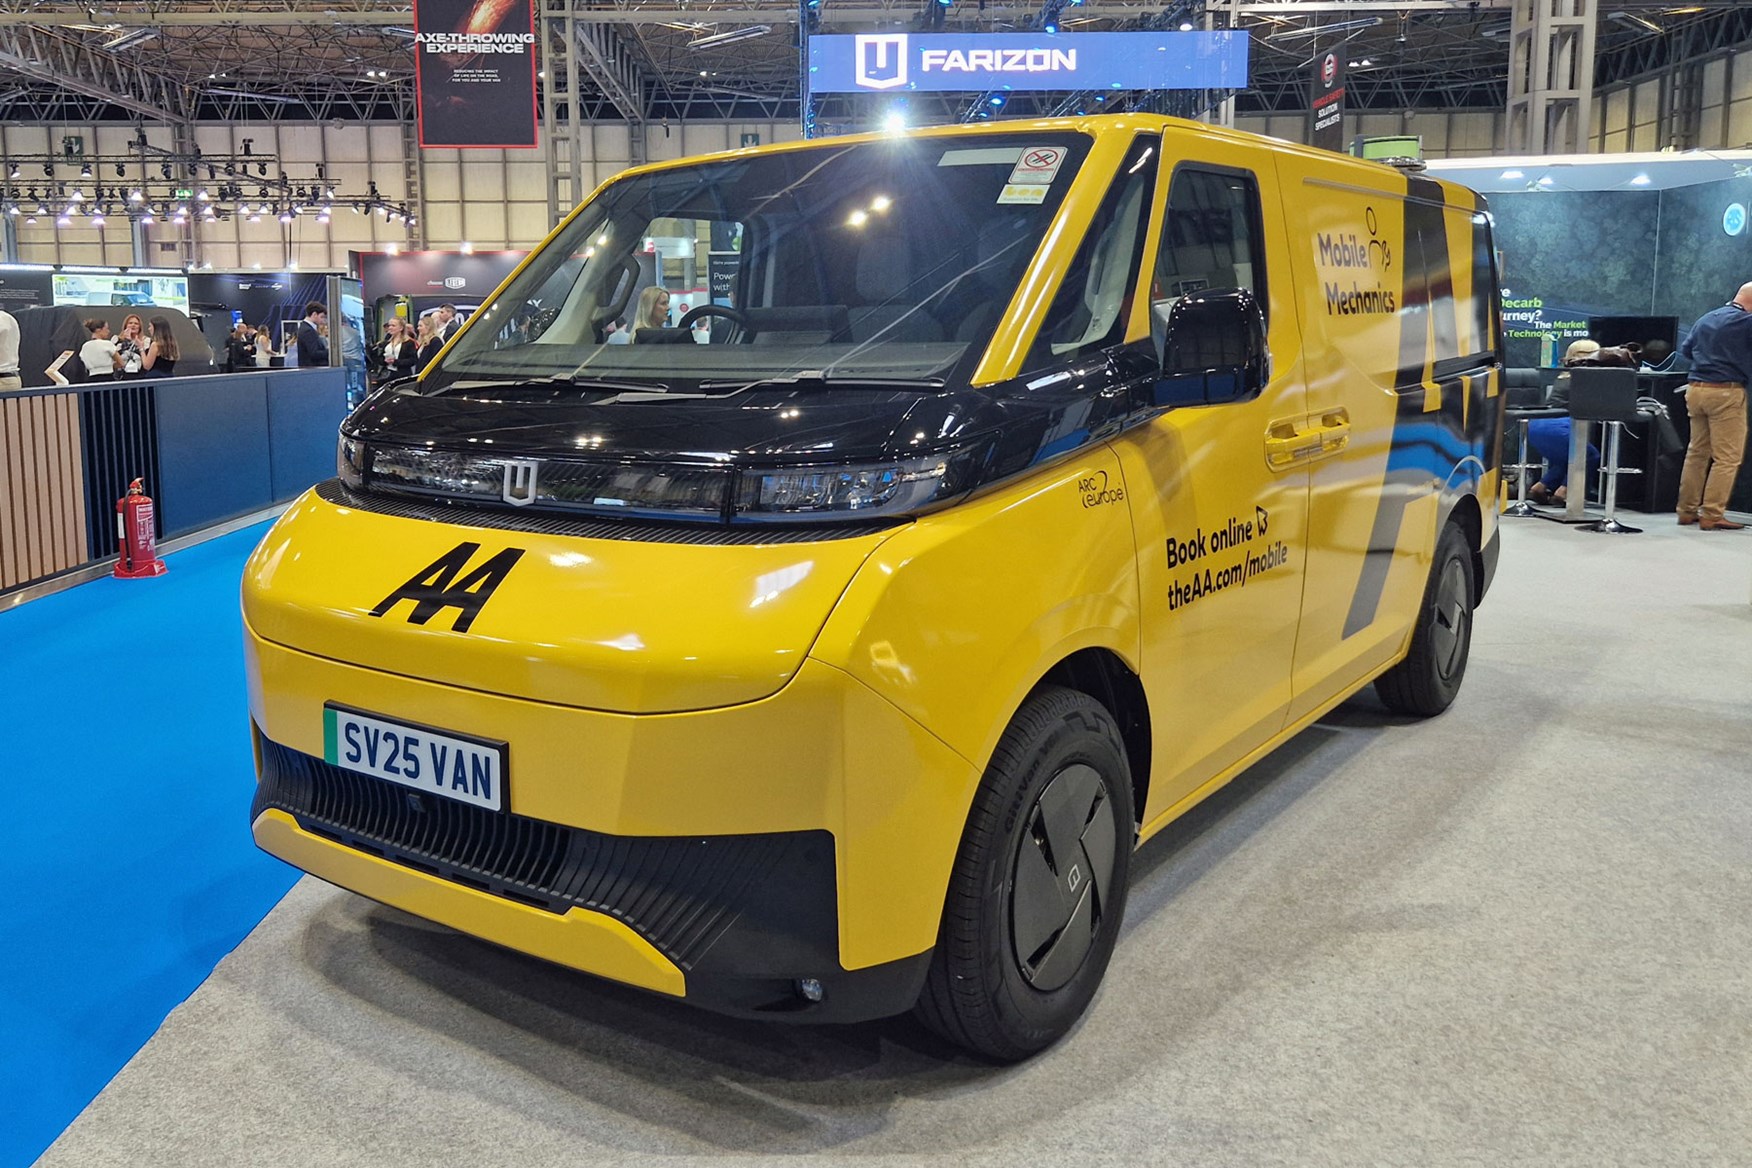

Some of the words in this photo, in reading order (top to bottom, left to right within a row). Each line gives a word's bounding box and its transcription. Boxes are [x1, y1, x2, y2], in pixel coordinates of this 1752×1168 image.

[415, 33, 534, 43] AXE-THROWING
[426, 43, 524, 53] EXPERIENCE
[922, 48, 1077, 72] FARIZON
[1318, 102, 1337, 117] SOLUTION
[1315, 113, 1339, 130] SPECIALISTS
[1318, 232, 1368, 268] Mobile
[1325, 281, 1395, 316] Mechanics
[1534, 321, 1552, 329] The
[1553, 320, 1586, 329] Market
[1563, 329, 1572, 338] is
[1078, 477, 1097, 493] ARC
[1086, 488, 1124, 507] europe
[1166, 528, 1206, 569] Book
[1211, 516, 1252, 553] online
[1168, 540, 1287, 611] theAA.com/mobile
[368, 541, 526, 633] AA
[344, 721, 420, 780] SV25
[430, 741, 491, 800] VAN
